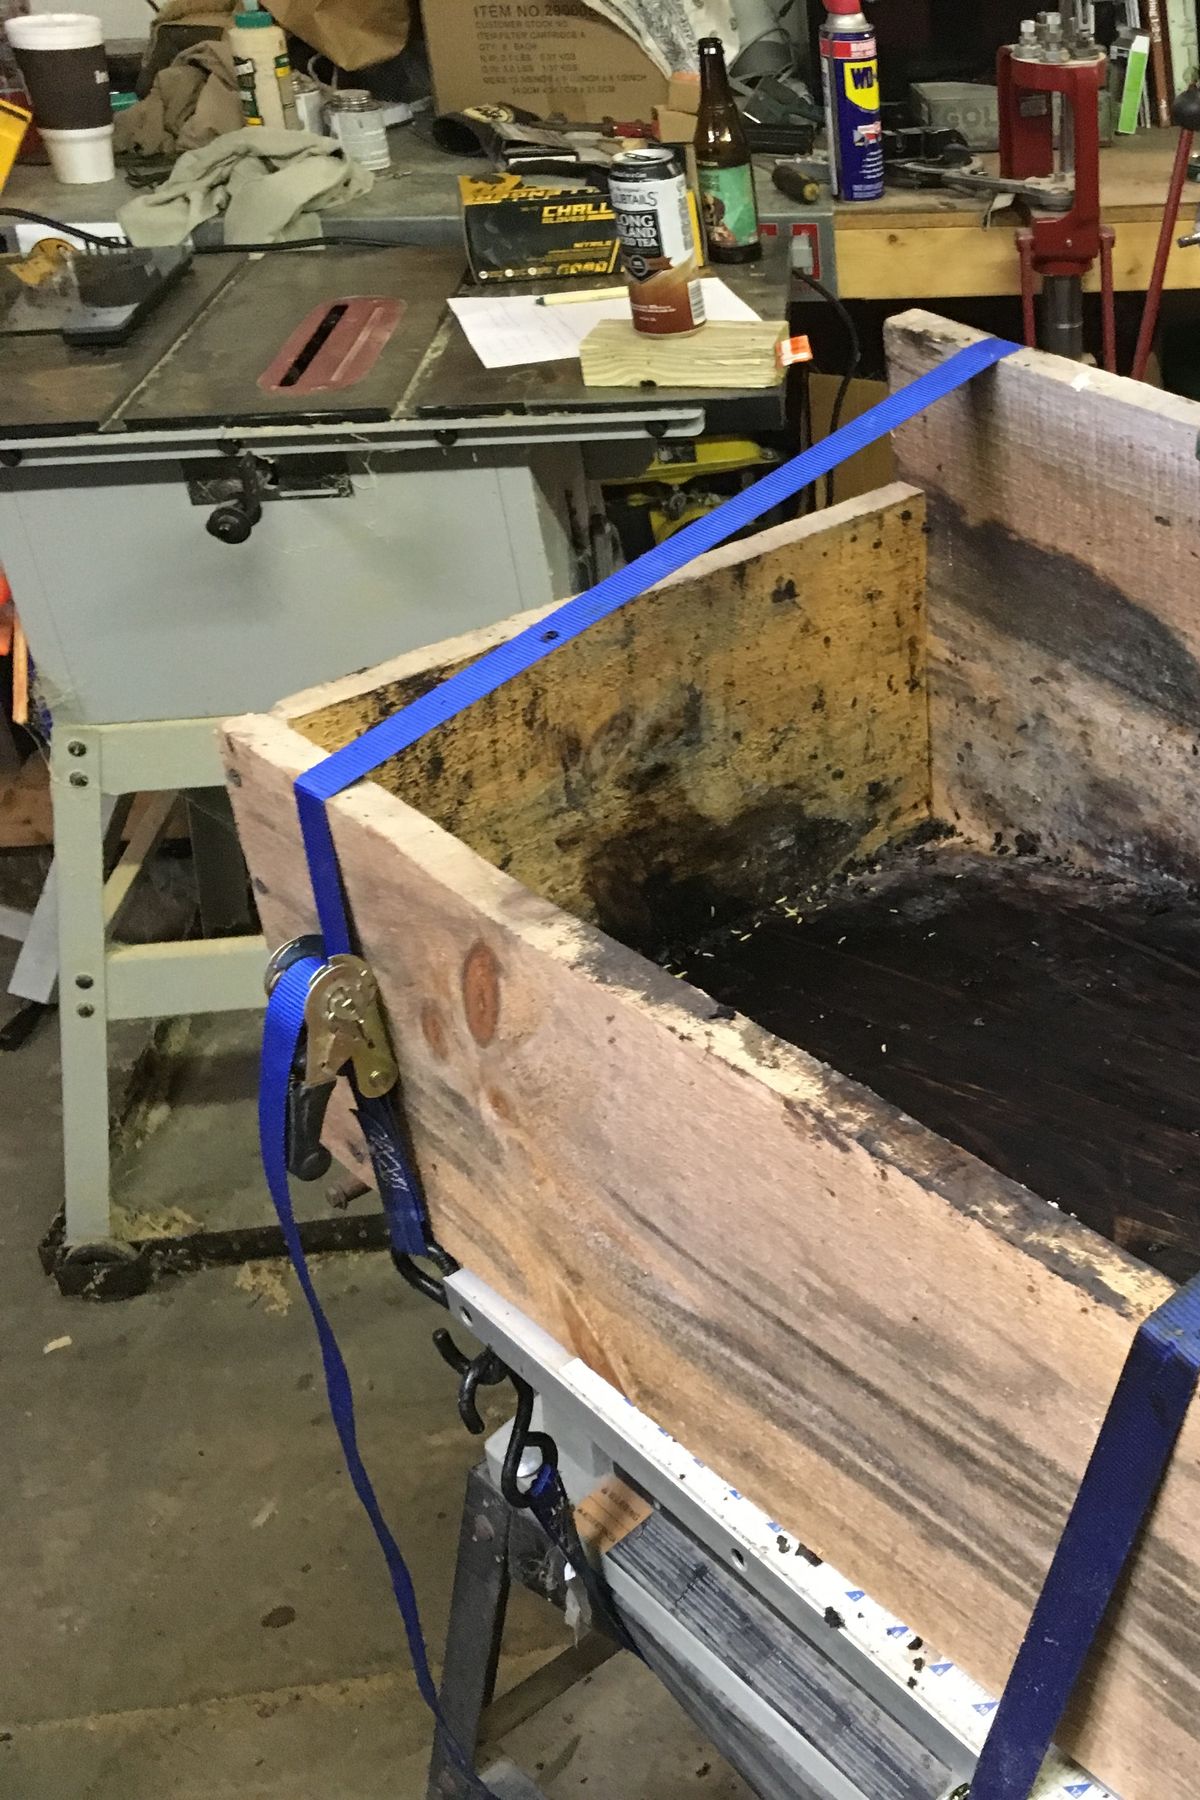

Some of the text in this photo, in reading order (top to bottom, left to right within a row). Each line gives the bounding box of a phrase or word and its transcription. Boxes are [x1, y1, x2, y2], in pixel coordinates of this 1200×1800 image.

[474, 5, 511, 18] ITEM
[517, 5, 540, 17] NO
[475, 21, 522, 29] CUSTOMER
[525, 20, 553, 28] STOCK
[637, 238, 659, 247] TEA
